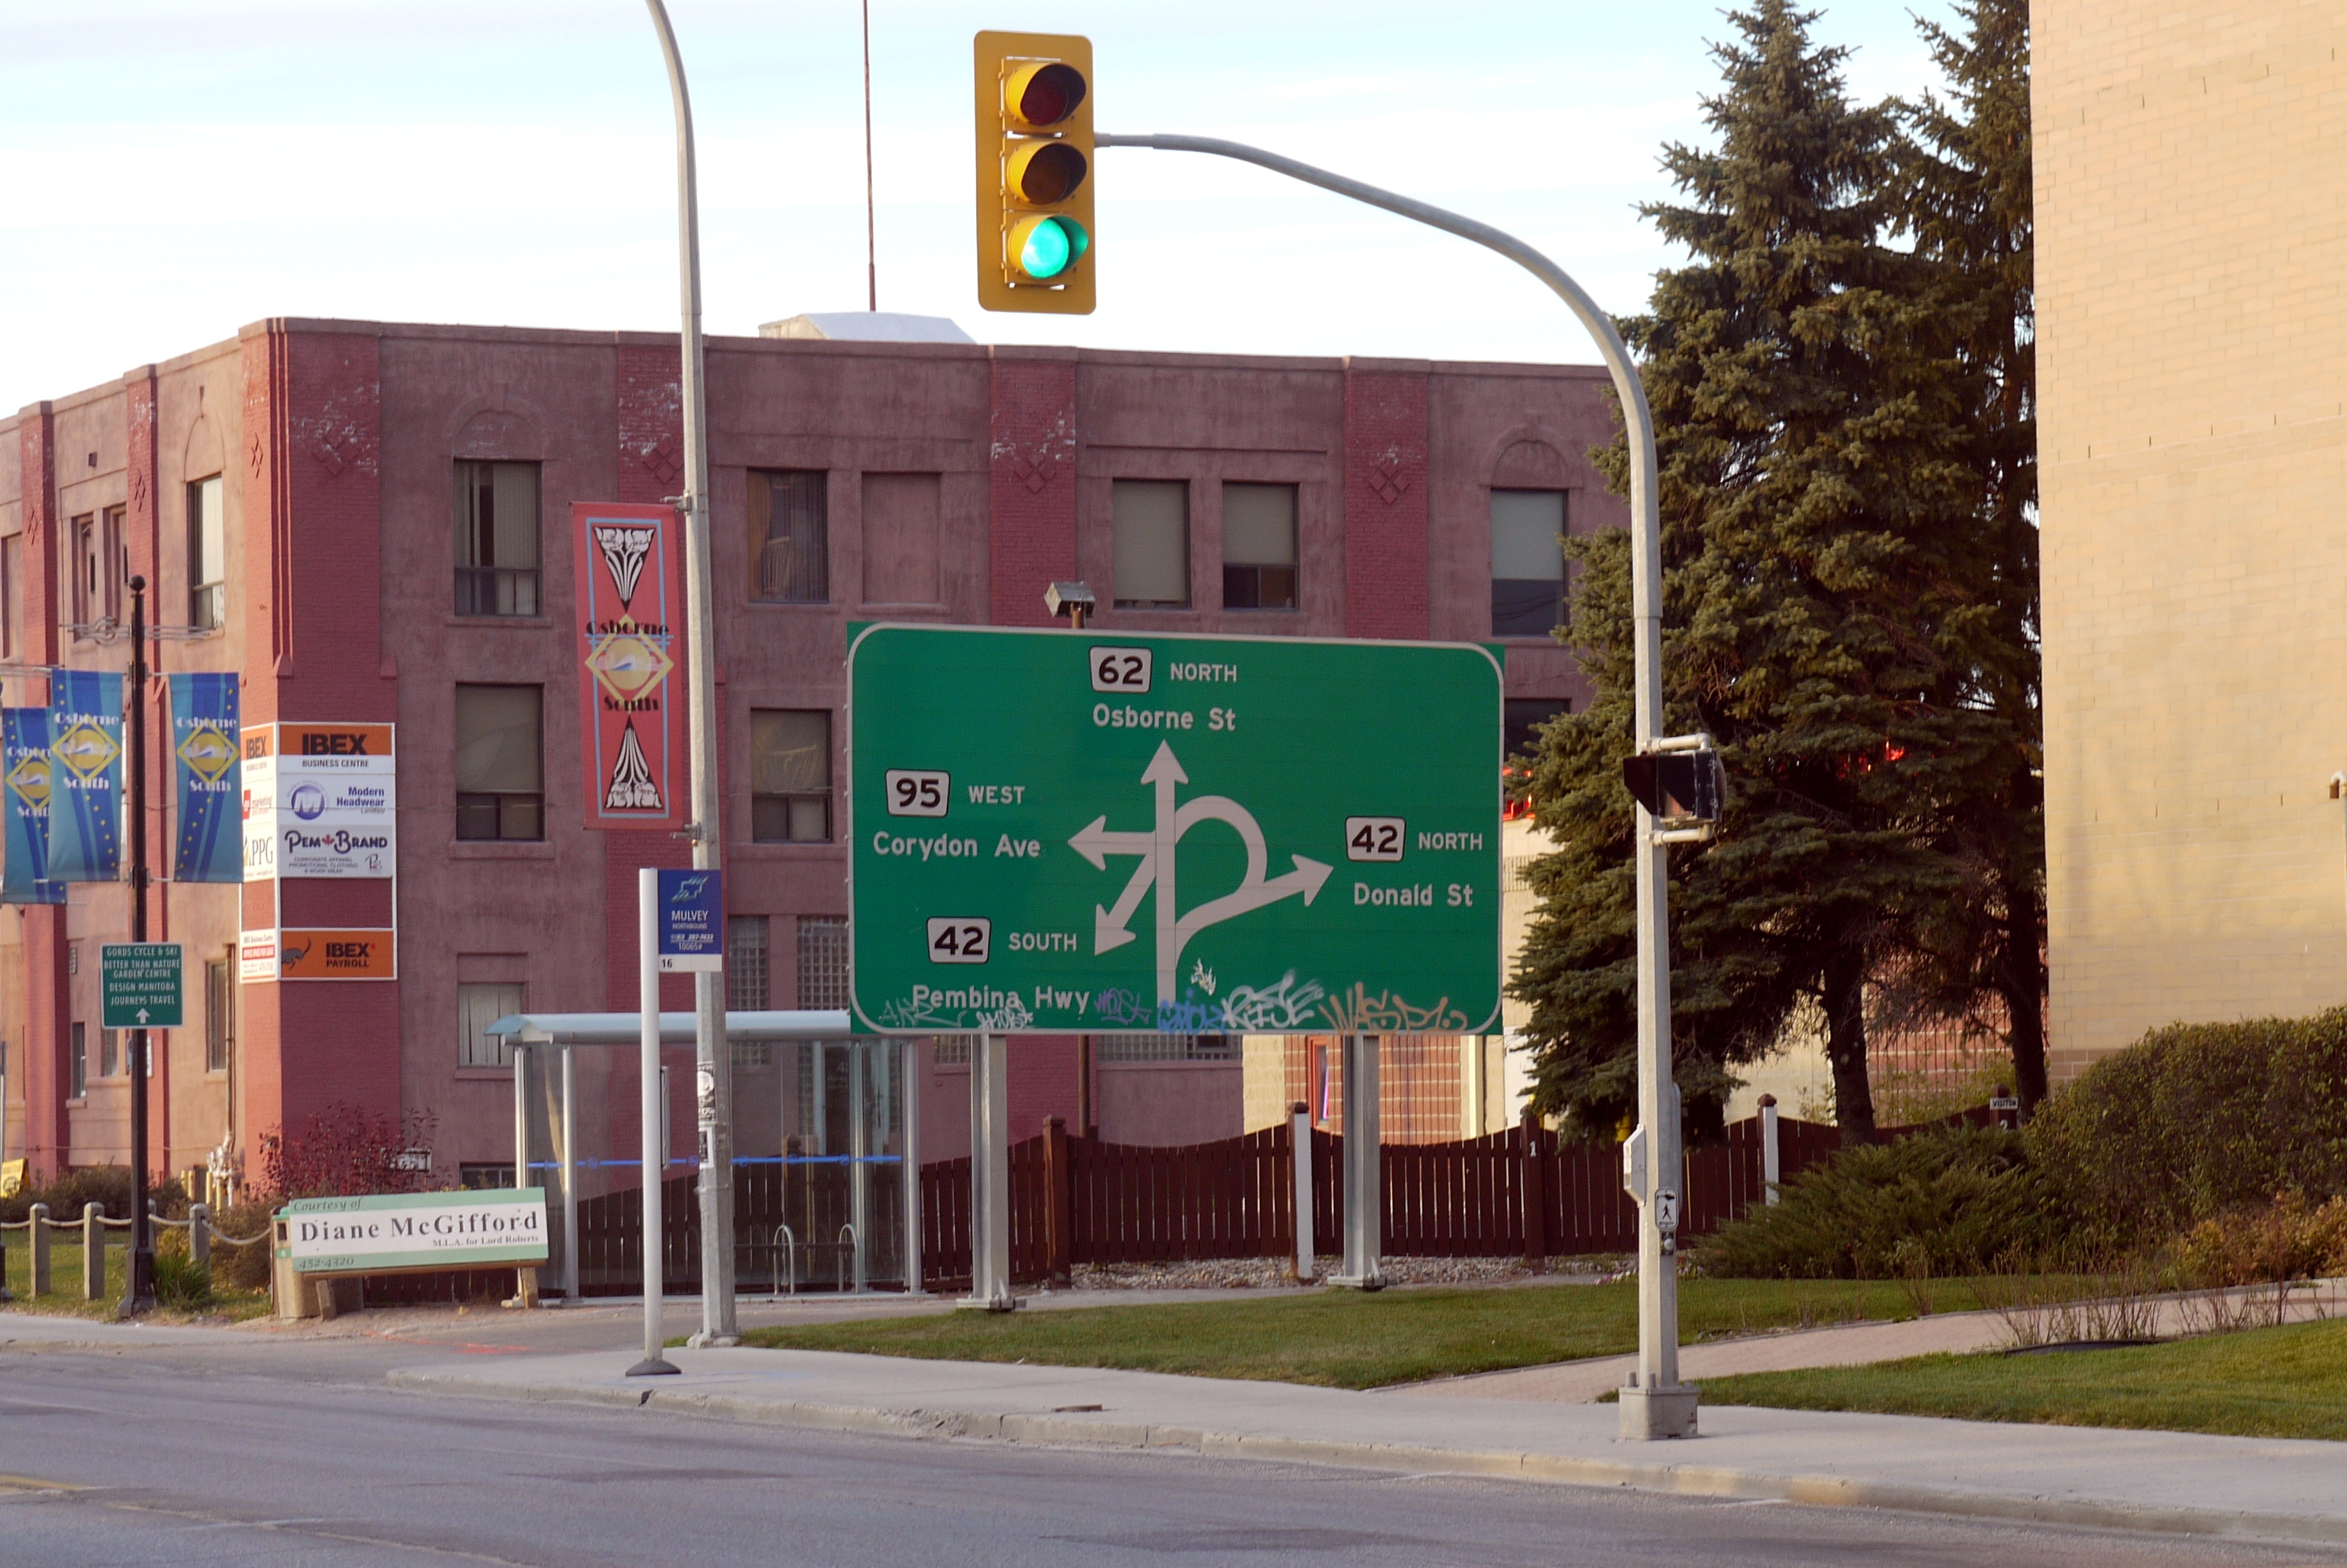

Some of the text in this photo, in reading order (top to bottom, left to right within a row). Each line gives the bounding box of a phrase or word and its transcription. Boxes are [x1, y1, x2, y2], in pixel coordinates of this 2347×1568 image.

[586, 619, 669, 635] Osborne
[1098, 655, 1237, 685] 62 NORTH
[605, 697, 659, 711] South
[1093, 703, 1236, 731] Osborne St
[246, 735, 267, 760] IBEX
[302, 733, 368, 755] IBEX
[302, 760, 339, 768] BUSINESS
[63, 777, 109, 789] South
[190, 780, 232, 792] South
[348, 787, 385, 797] Modern
[896, 778, 1025, 808] 95 WEST
[337, 797, 385, 807] Headwear
[1352, 824, 1482, 853] 42 NORTH
[873, 831, 1041, 862] Corydon Ave
[1354, 882, 1473, 907] Donald St
[672, 910, 708, 921] MULVEY
[934, 926, 1077, 956] 42 SOUTH
[107, 948, 131, 956] GORDS
[135, 948, 154, 956] CYCLE
[166, 948, 177, 956] SKI
[326, 943, 369, 957] IBEX
[104, 959, 180, 969] BETTER THAN NATURE
[661, 958, 672, 968] 16
[114, 969, 171, 979] GARDEN CENTRE
[109, 982, 175, 992] DESIGN MANITOBA
[111, 995, 175, 1006] JOURNEYS TRAVEL
[913, 985, 1090, 1015] Pembina Hwy
[1530, 1140, 1537, 1157] 1
[294, 1199, 361, 1211] Courtesy of
[301, 1211, 538, 1241] Diane McGifford
[481, 1237, 503, 1245] Lord
[506, 1235, 539, 1243] Roberts
[299, 1257, 354, 1269] 452-4320
